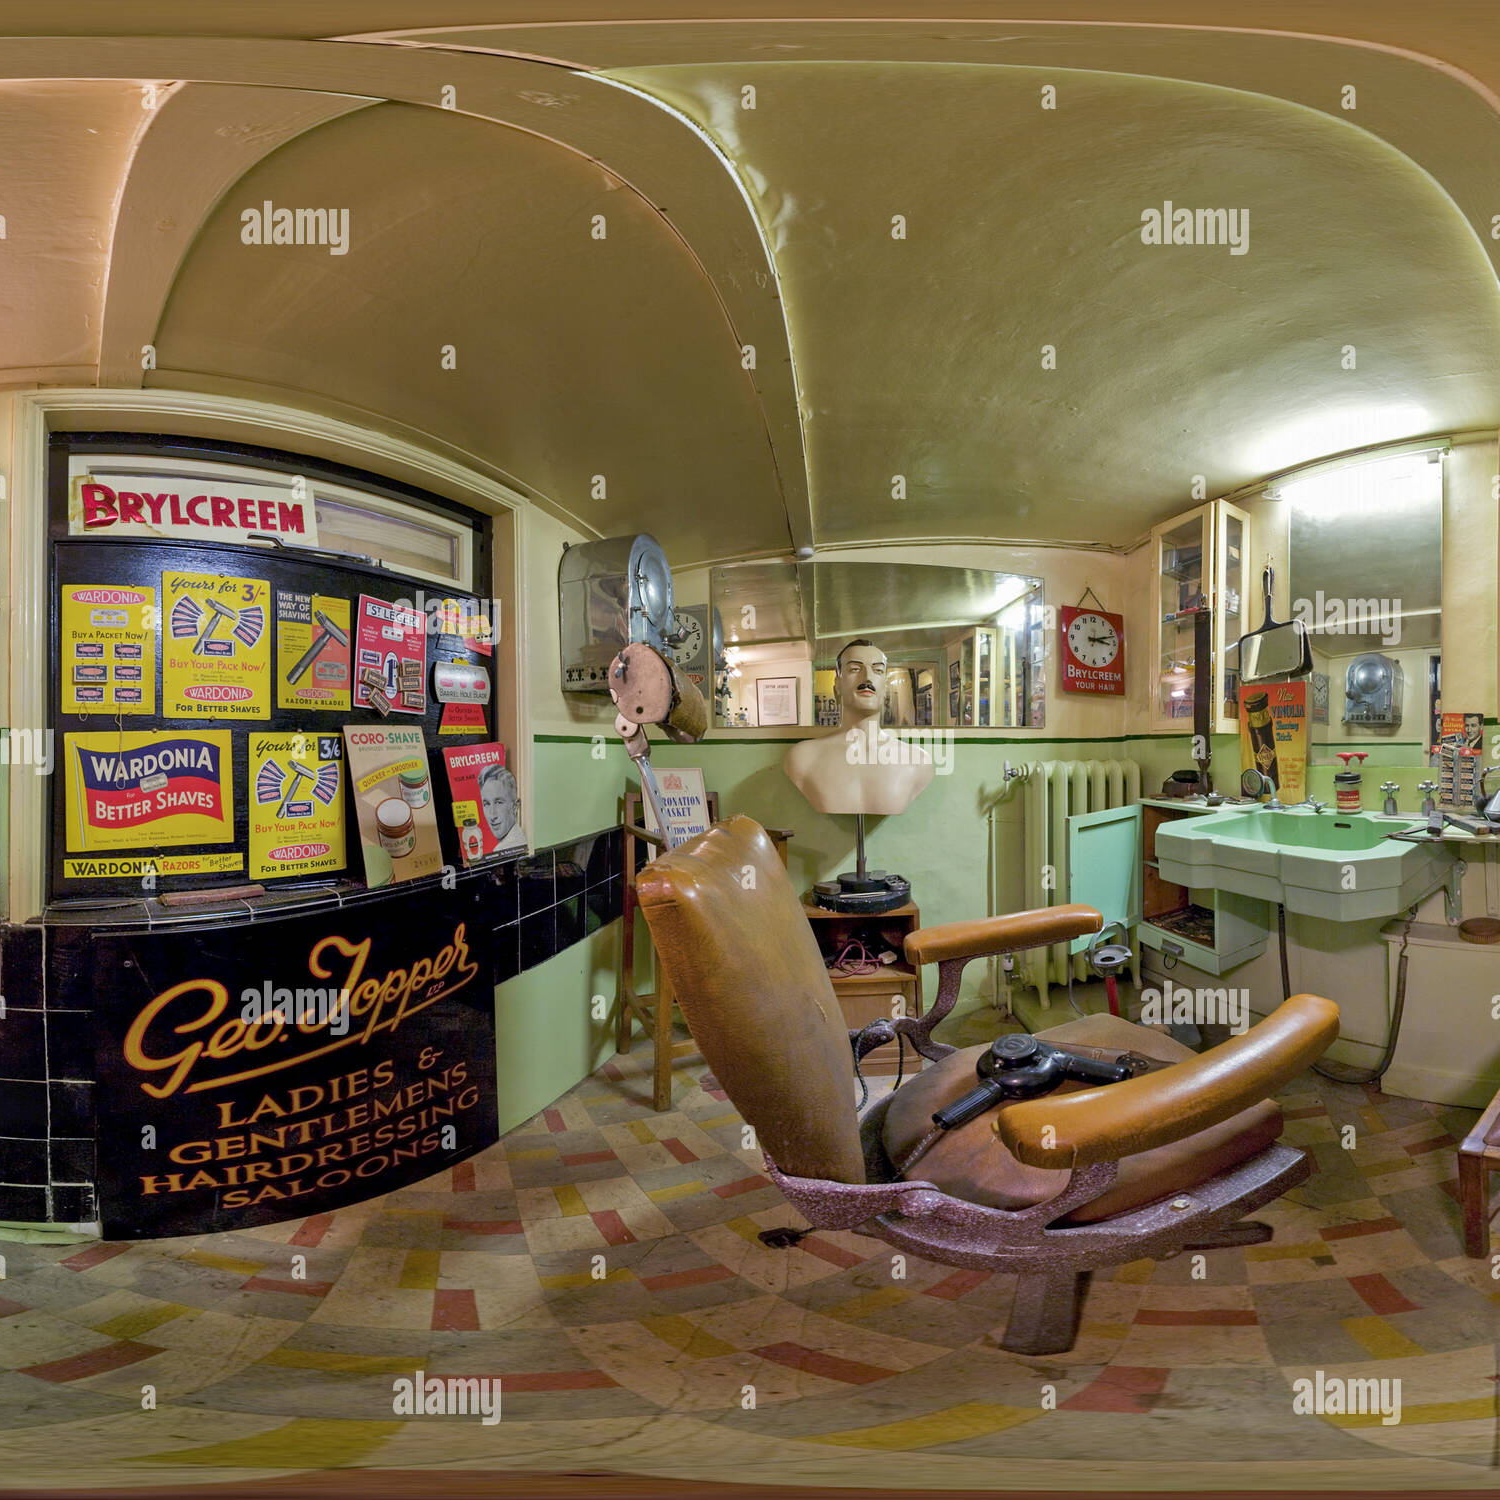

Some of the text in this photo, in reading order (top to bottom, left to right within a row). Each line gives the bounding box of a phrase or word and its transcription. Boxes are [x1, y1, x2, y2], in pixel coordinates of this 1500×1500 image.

[81, 483, 305, 534] BRYLCREEM
[171, 577, 215, 594] Yours
[218, 581, 237, 593] for
[76, 591, 141, 603] WARDONIA
[279, 592, 311, 603] THE NEW
[278, 602, 297, 610] WAY
[278, 611, 311, 620] SHAVING
[96, 631, 123, 639] PACKET
[1067, 664, 1121, 681] BRYLCREEM
[189, 687, 250, 700] WARDONIA
[1076, 681, 1115, 691] YOUR HAIR
[197, 704, 228, 713] BETTER
[231, 705, 260, 713] SHAVES
[1271, 704, 1305, 718] VINOLIA
[256, 739, 296, 758] Yours
[320, 738, 340, 760] 3/6
[90, 746, 214, 783] WARDONIA
[450, 751, 499, 768] BRYLCREEM
[363, 762, 418, 788] QUICKER SMOOTHER
[95, 791, 214, 820] BETTER SHAVES
[661, 796, 700, 806] RONATION
[667, 807, 691, 817] ASKET
[273, 843, 326, 859] WARDONIA
[162, 861, 200, 871] RAZORS
[261, 859, 337, 873] FOR BETTER SHAVES
[123, 922, 479, 1099] Geo. Topper
[216, 1047, 444, 1129] LADIES &
[169, 1062, 468, 1165] GENTLEMENS
[140, 1086, 479, 1196] HAIRDRESSING
[222, 1132, 440, 1209] SALOONS
